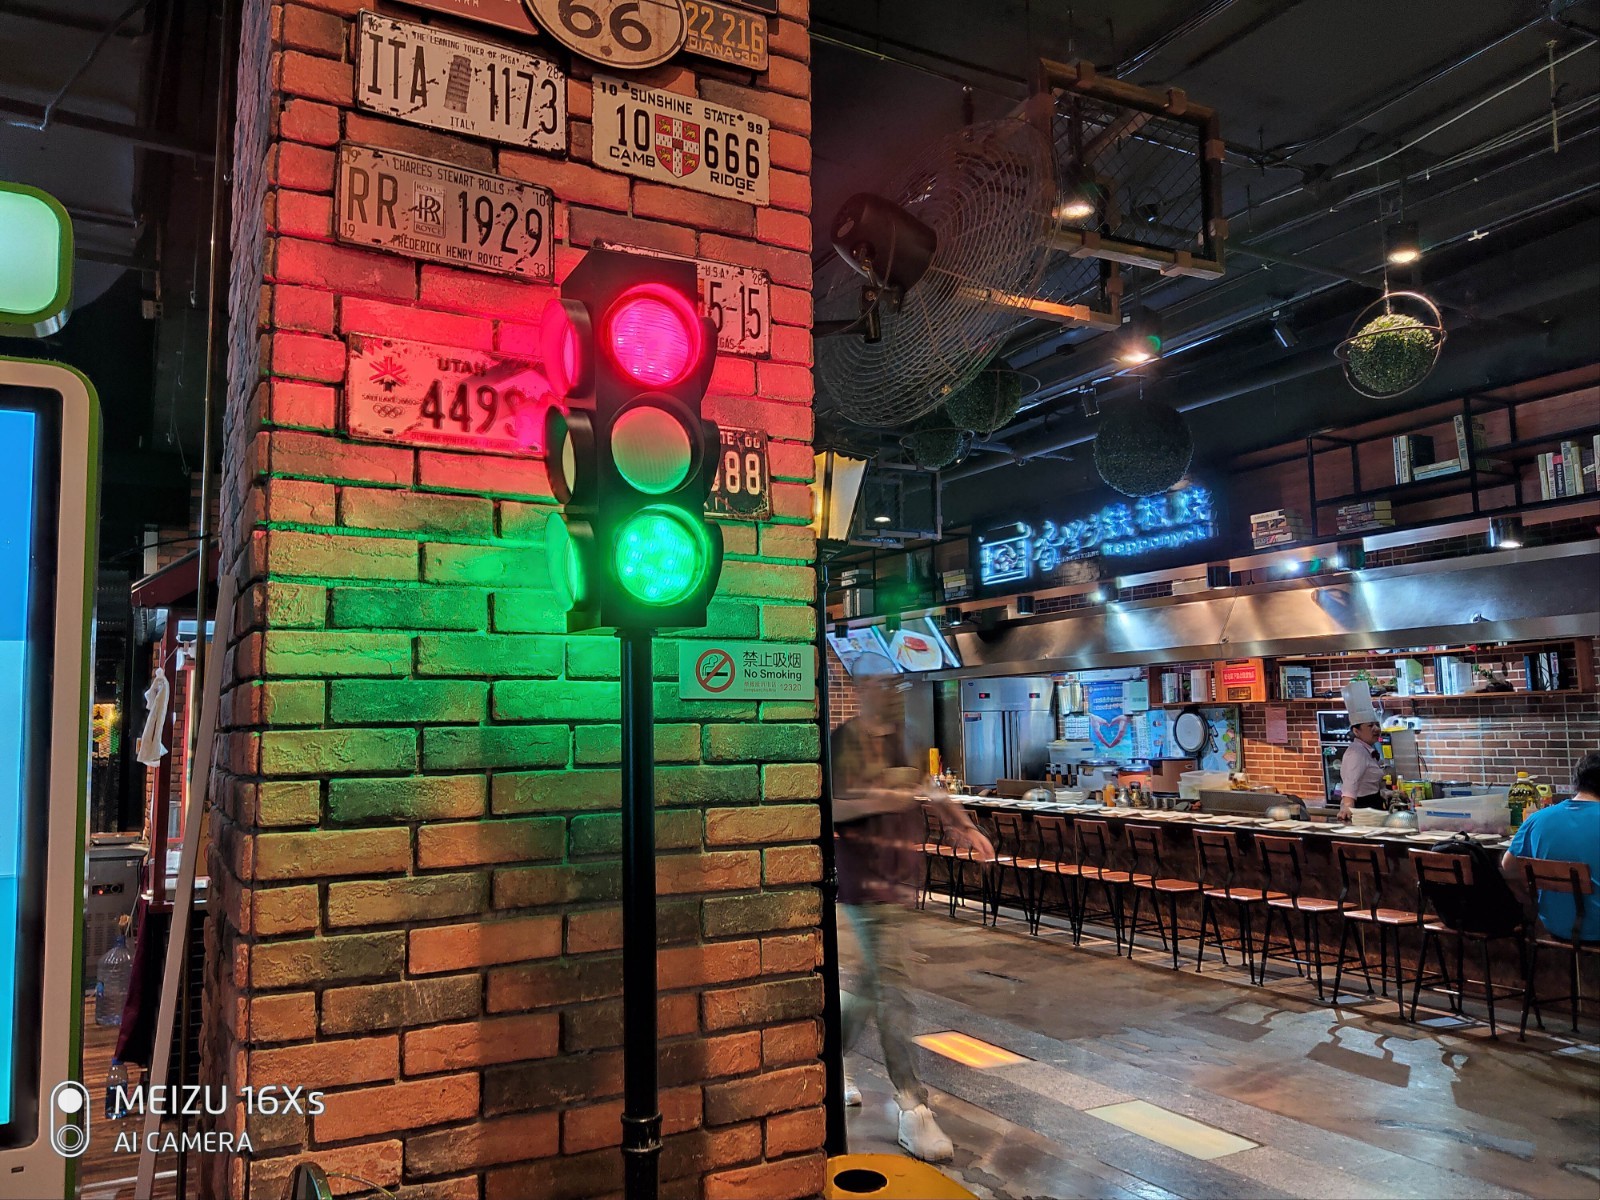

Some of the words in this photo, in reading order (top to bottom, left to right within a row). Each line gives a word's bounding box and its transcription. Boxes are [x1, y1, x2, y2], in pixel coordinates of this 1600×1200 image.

[558, 0, 652, 51] 66
[722, 13, 764, 54] 216
[430, 35, 460, 50] LEANING
[464, 43, 485, 56] TOWER
[687, 36, 760, 64] DIANA-30
[546, 65, 559, 79] 28
[367, 32, 428, 107] ITA
[487, 63, 558, 135] 1173
[600, 82, 618, 96] 10
[630, 88, 693, 115] SUNSHINE
[704, 107, 737, 127] STATE
[450, 116, 476, 131] ITALY
[747, 122, 763, 135] 99
[616, 104, 650, 152] 10
[704, 127, 760, 180] 666
[394, 158, 433, 178] CHARLES
[437, 169, 475, 190] STEWART
[478, 178, 505, 196] ROLLS
[609, 146, 656, 168] CAMB
[710, 171, 756, 192] RIDGE
[348, 167, 398, 230] RR
[458, 191, 543, 258] 1929
[343, 222, 356, 237] 19
[416, 224, 442, 236] ROYCE
[393, 235, 441, 255] FREDERICK
[446, 246, 473, 261] HENRY
[477, 254, 503, 268] ROYCE
[534, 263, 546, 277] 33
[719, 337, 735, 350] GAS
[437, 357, 488, 377] UTAH
[711, 451, 761, 495] 88
[743, 651, 802, 669] 禁止吸烟
[744, 669, 758, 679] No
[760, 669, 802, 682] Smoking
